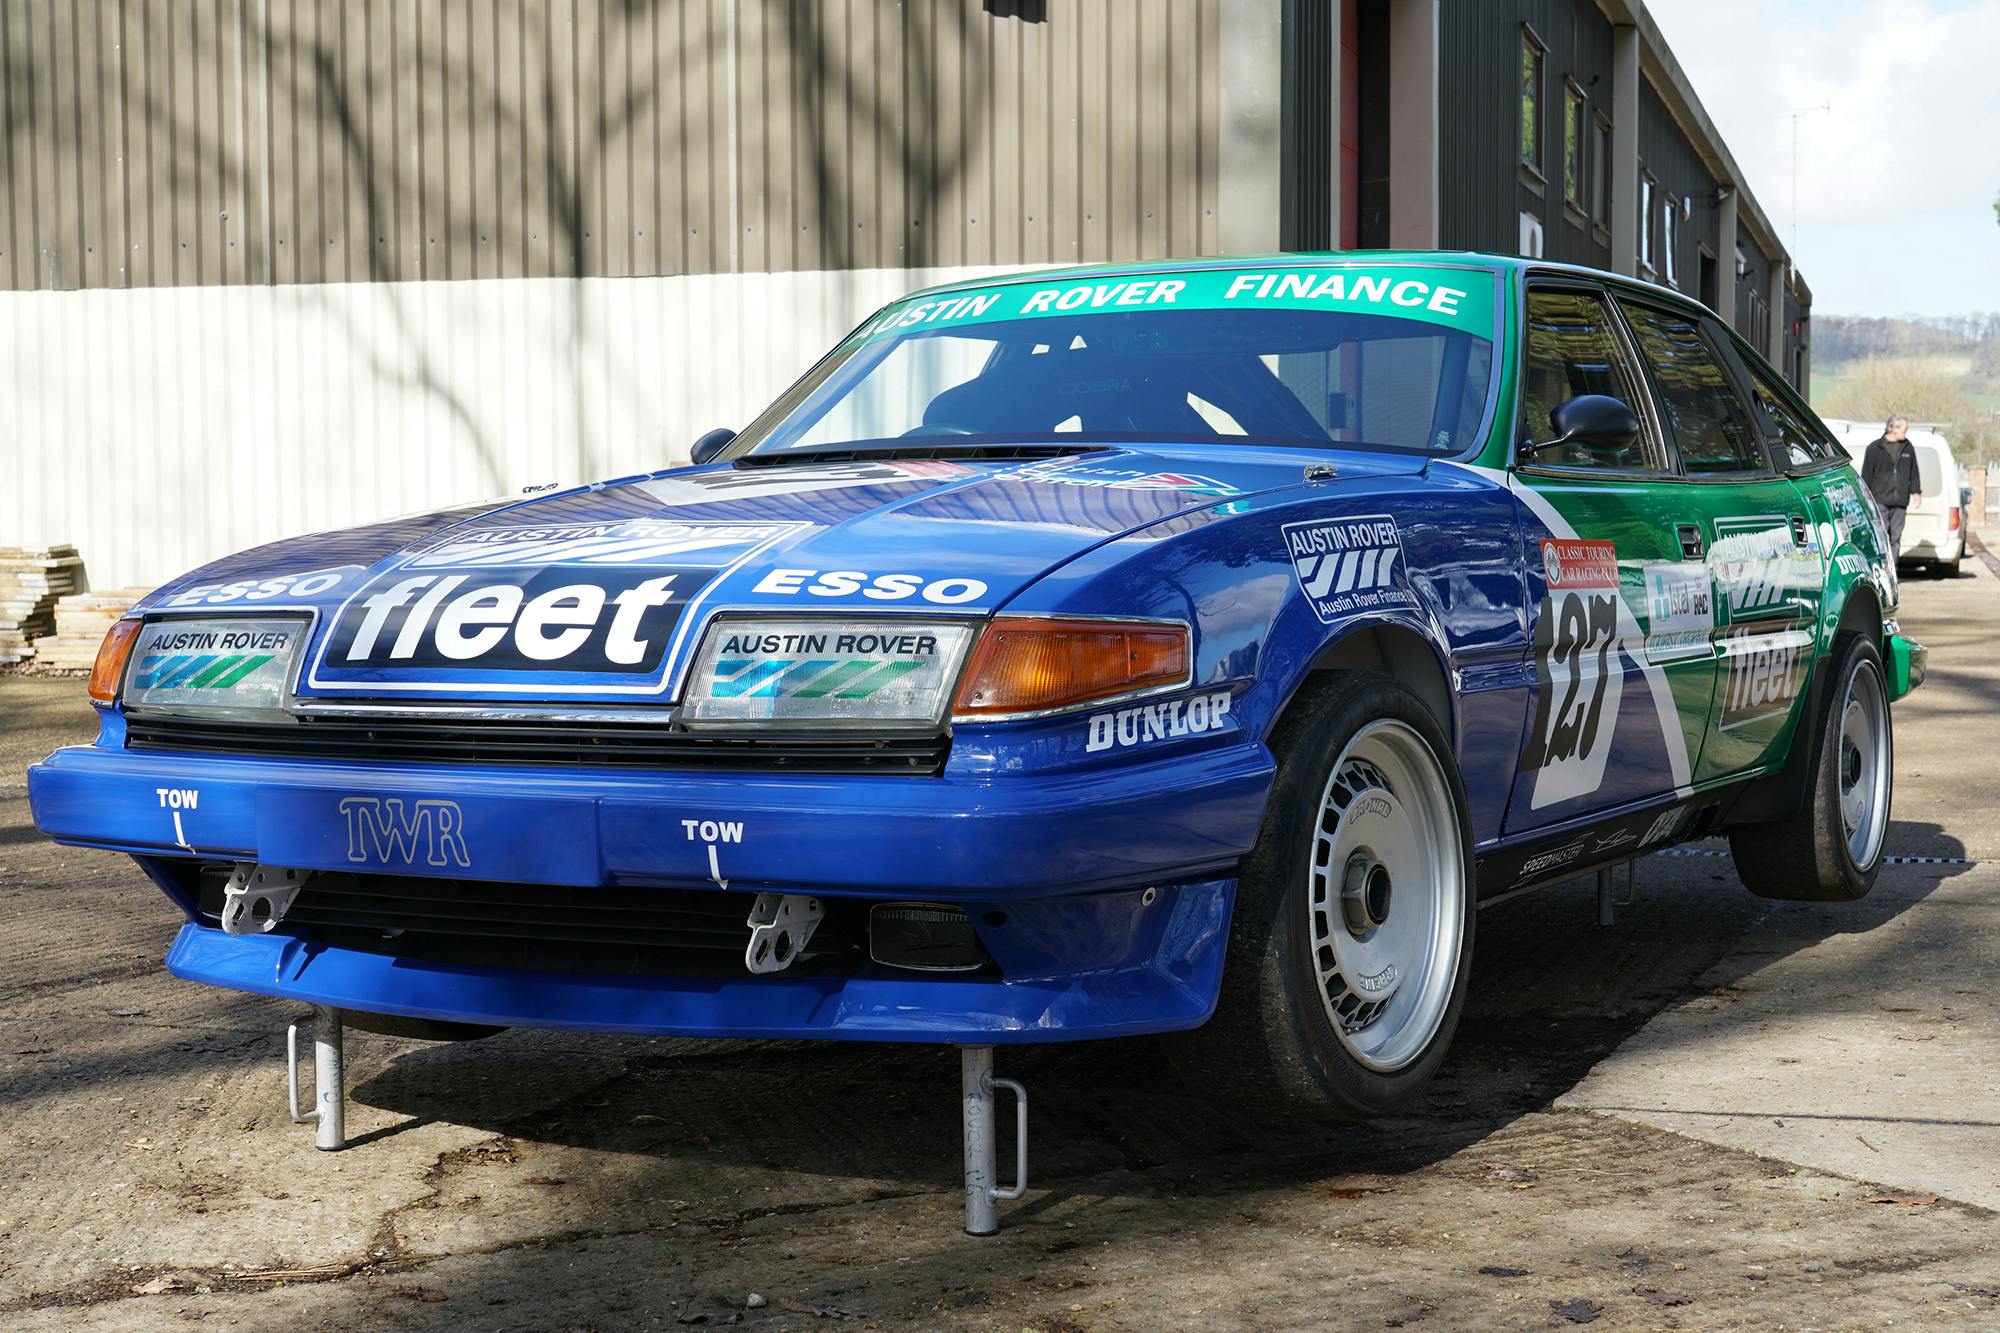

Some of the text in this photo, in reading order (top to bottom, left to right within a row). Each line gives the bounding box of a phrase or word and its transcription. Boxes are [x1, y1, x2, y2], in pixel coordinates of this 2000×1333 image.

[851, 274, 1468, 343] AUSTIN ROVER FINANCE
[458, 524, 778, 543] AUSTIN ROVER
[1291, 522, 1398, 556] AUSTIN ROVER
[1557, 546, 1616, 560] CLASSIC TOURING
[752, 567, 988, 604] ESSO
[1561, 567, 1575, 581] CAR
[1576, 567, 1601, 581] RACING
[169, 572, 344, 607] ESSO
[1319, 595, 1354, 616] Austin
[1354, 592, 1378, 609] Rover
[1693, 593, 1708, 615] RAC
[346, 574, 678, 665] fleet
[148, 632, 289, 650] AUSTIN ROVER
[722, 634, 938, 655] AUSTIN ROVER
[1731, 622, 1797, 712] fleet
[1519, 592, 1617, 772] 127
[1086, 691, 1232, 754] DUNLOP
[156, 788, 198, 810] TOW
[339, 796, 471, 867] TWR
[682, 819, 744, 844] TOW
